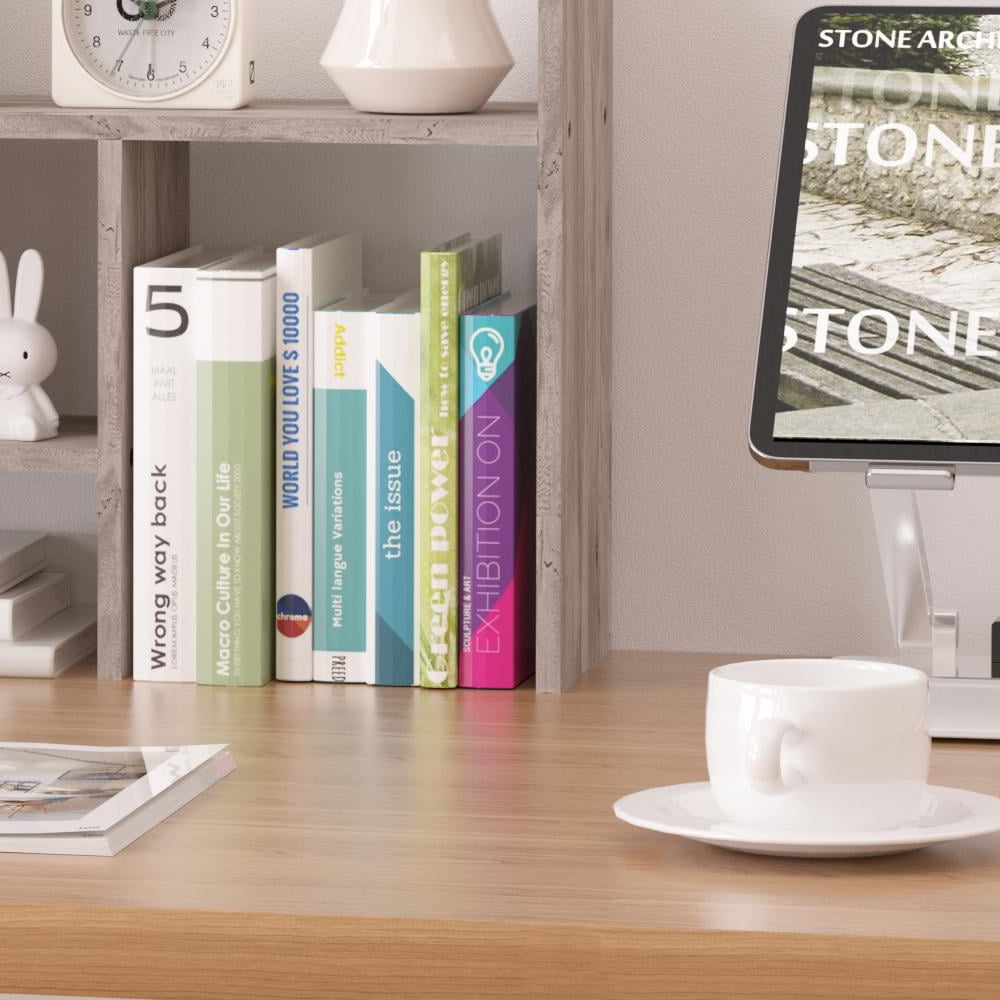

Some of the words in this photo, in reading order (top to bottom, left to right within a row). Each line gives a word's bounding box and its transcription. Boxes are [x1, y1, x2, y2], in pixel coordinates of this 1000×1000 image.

[83, 4, 92, 16] 9
[210, 6, 219, 18] 3
[92, 36, 101, 48] 8
[117, 29, 140, 37] WASTE
[142, 29, 159, 37] FREE
[160, 29, 175, 37] CITY
[202, 37, 210, 49] 4
[818, 29, 912, 49] STONE
[917, 30, 1000, 49] ARCH
[115, 60, 124, 72] 7
[146, 65, 155, 81] 6
[179, 61, 187, 73] 5
[440, 258, 450, 317] energy
[145, 285, 189, 338] 5
[282, 292, 299, 345] 10000
[334, 323, 347, 378] Addict
[440, 321, 449, 358] save
[282, 365, 299, 406] LOVE
[439, 365, 449, 379] to
[439, 382, 449, 417] how
[282, 410, 299, 445] YOU
[476, 415, 501, 465] ON
[151, 464, 167, 526] back
[216, 462, 231, 491] Life
[282, 450, 299, 509] WORLD
[384, 450, 402, 512] issue
[431, 427, 449, 551] power
[216, 496, 231, 527] Our
[331, 472, 343, 540] Variations
[154, 535, 170, 584] way
[216, 532, 231, 549] In
[382, 519, 401, 560] the
[216, 552, 231, 615] Culture
[331, 544, 347, 591] langue
[463, 576, 472, 593] ART
[476, 476, 501, 654] EXHIBITION
[151, 593, 170, 670] Wrong
[277, 611, 308, 621] chroma
[331, 596, 343, 628] Multi
[427, 563, 449, 684] Green
[463, 602, 472, 653] SCULPTURE
[216, 622, 231, 677] Macro
